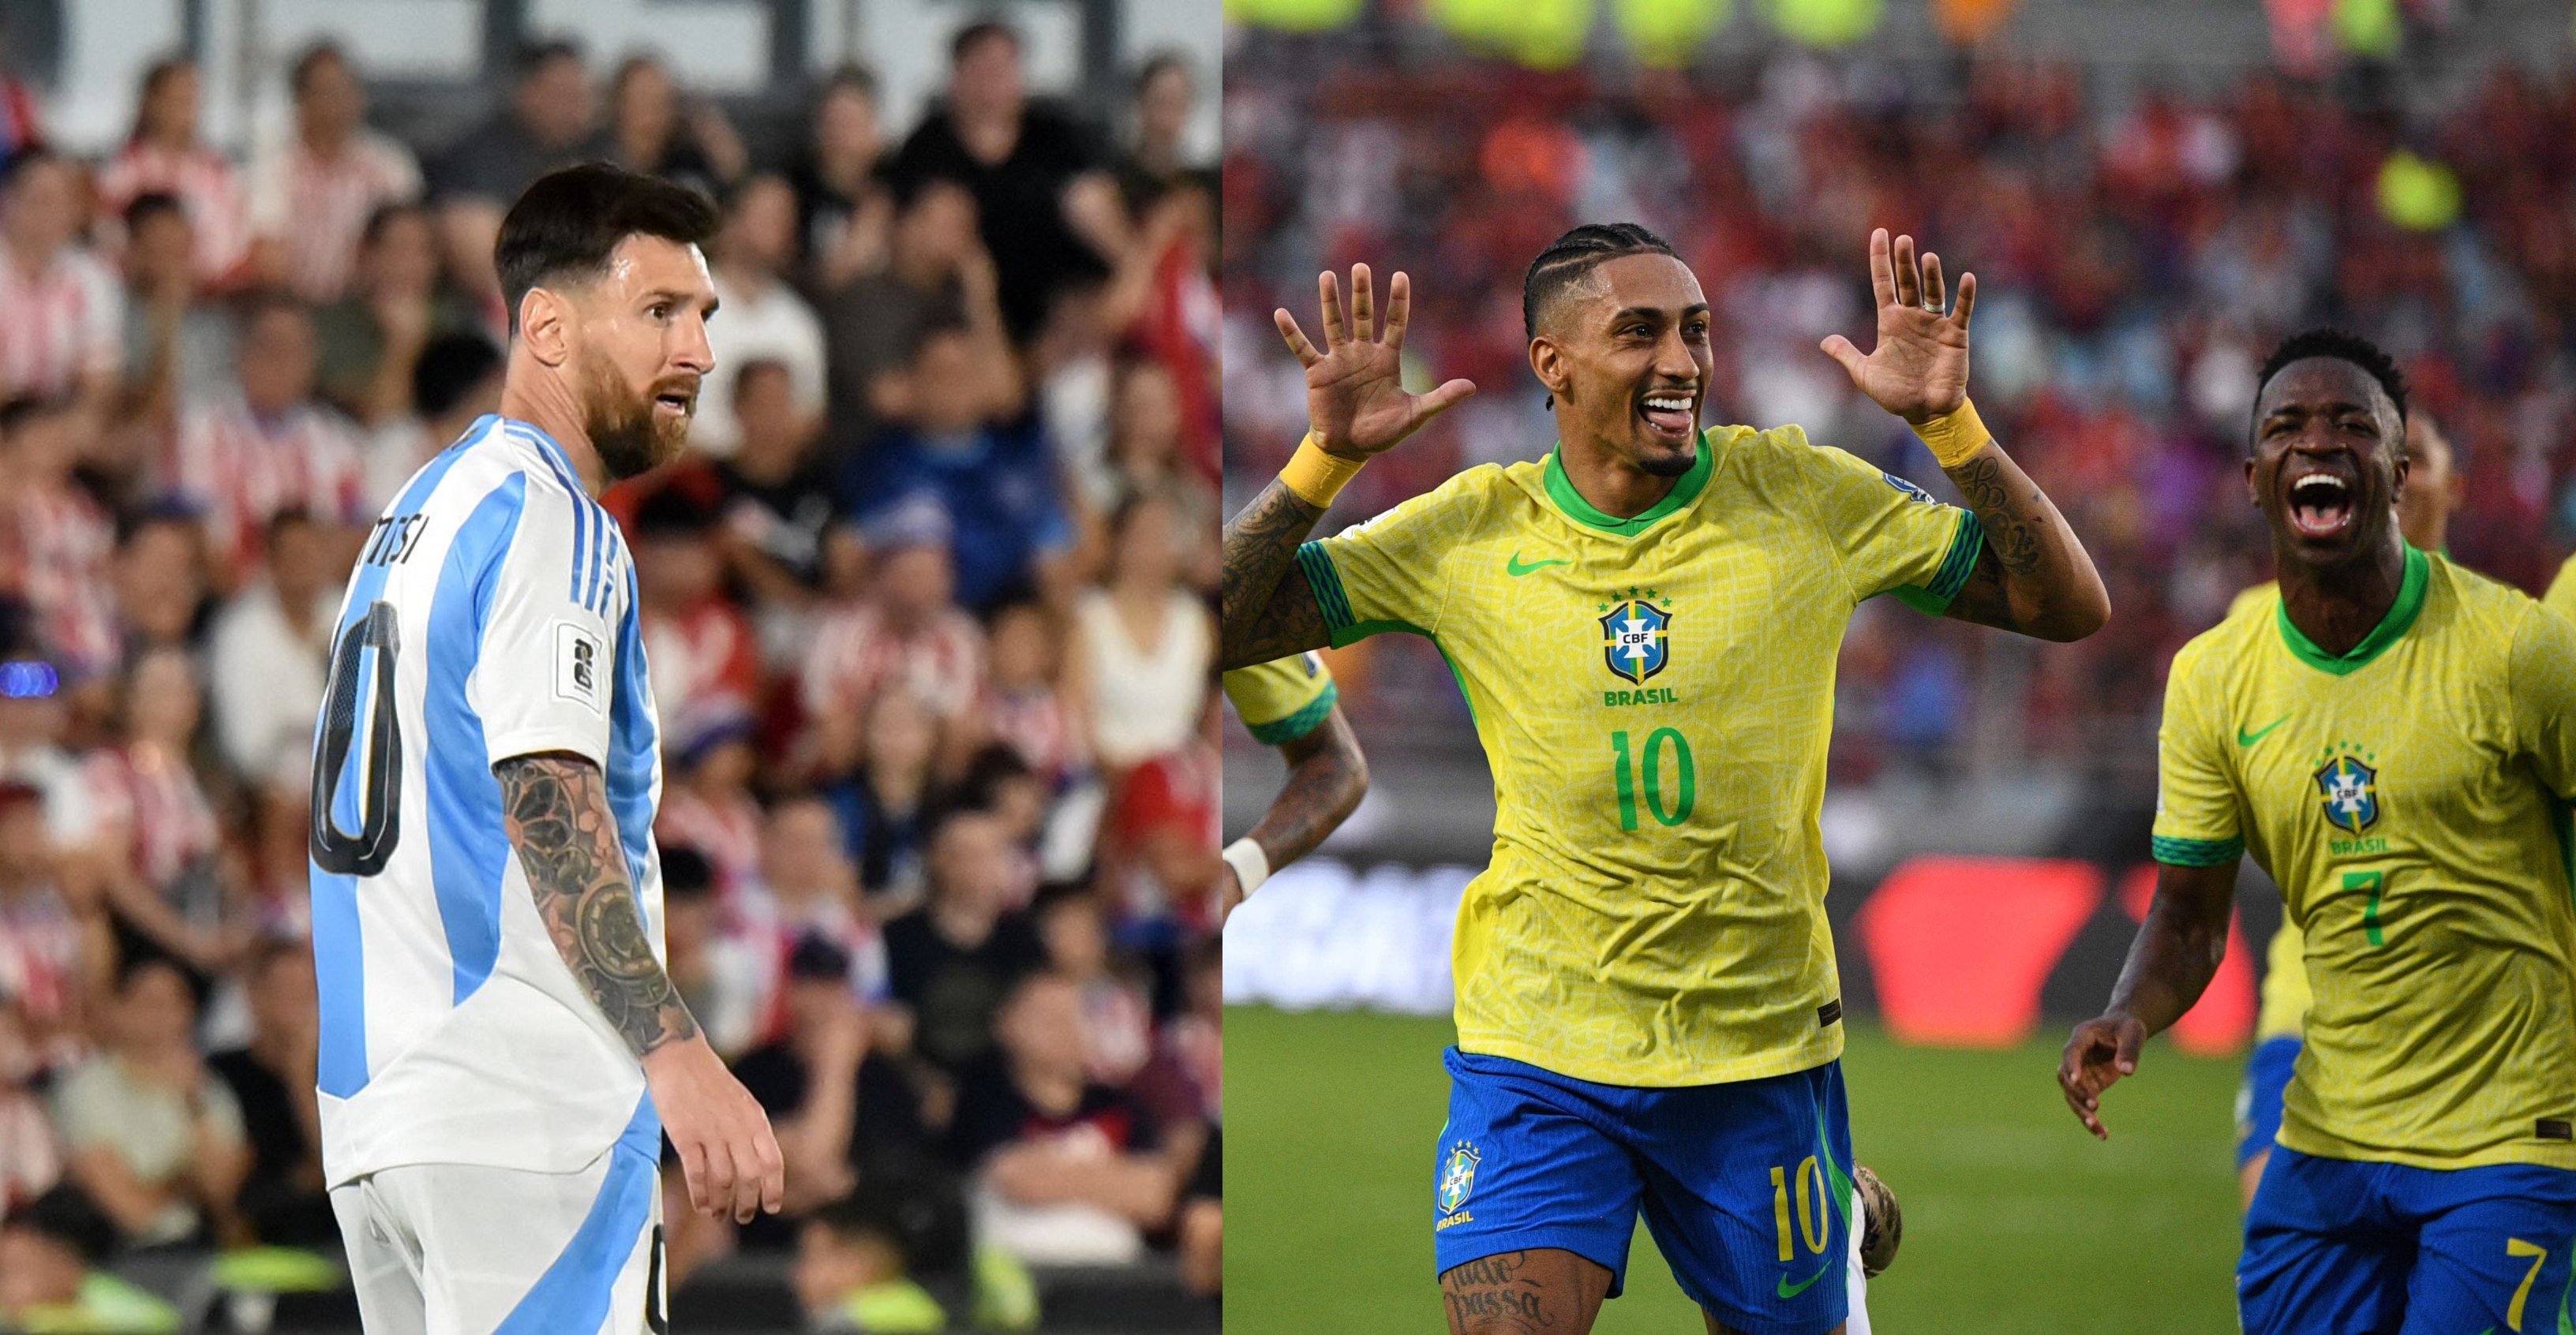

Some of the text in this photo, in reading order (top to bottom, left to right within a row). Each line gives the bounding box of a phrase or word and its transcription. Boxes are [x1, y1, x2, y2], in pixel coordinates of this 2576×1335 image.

[1622, 632, 1649, 645] CBF
[1604, 687, 1679, 707] BRASIL
[1611, 727, 1696, 831] 10
[2336, 789, 2359, 800] CBF
[2331, 838, 2391, 856] BRASIL
[2342, 871, 2384, 947] 7
[1449, 1175, 1463, 1186] CBF
[1769, 1154, 1829, 1262] 10
[1436, 1210, 1474, 1232] BRASIL
[2506, 1236, 2548, 1333] 7
